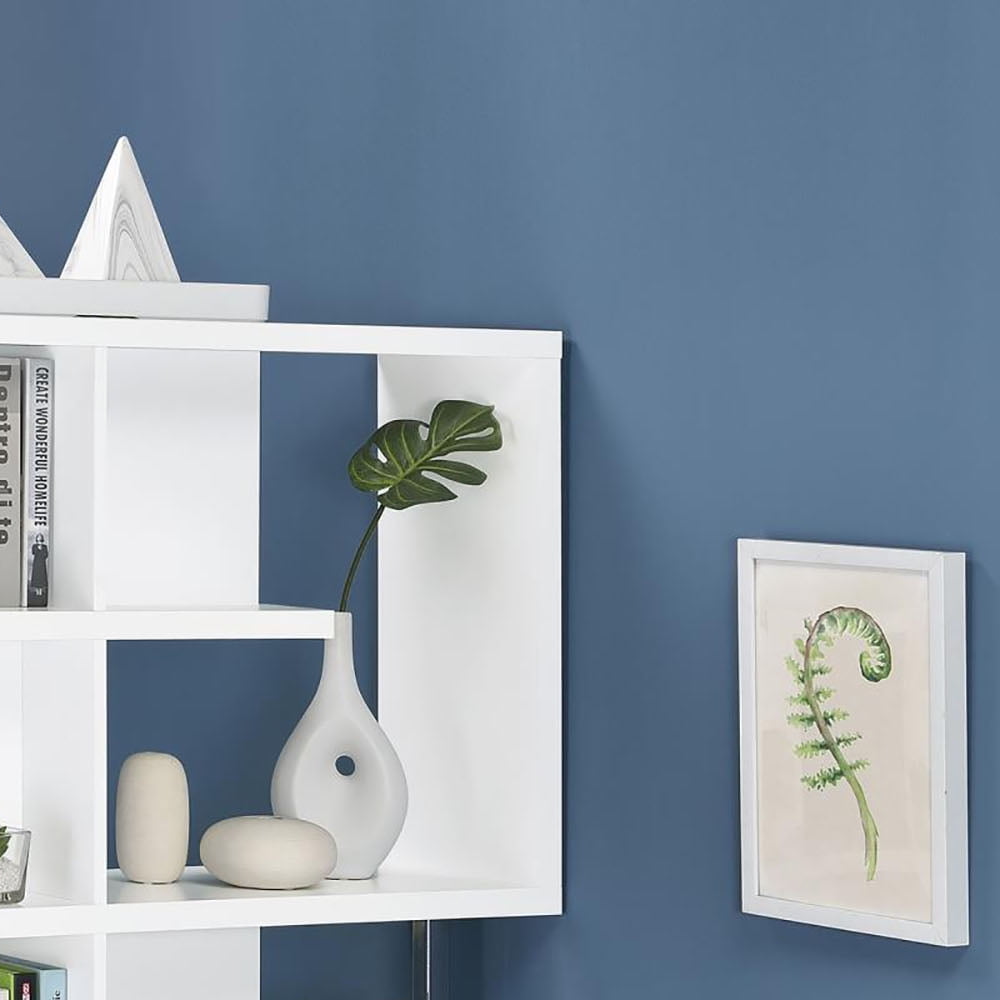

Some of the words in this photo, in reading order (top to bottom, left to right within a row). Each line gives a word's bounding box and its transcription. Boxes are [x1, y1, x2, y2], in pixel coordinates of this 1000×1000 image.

[35, 367, 48, 403] CREATE
[34, 408, 48, 472] WONDERFUL
[34, 476, 48, 526] HOMELIFE
